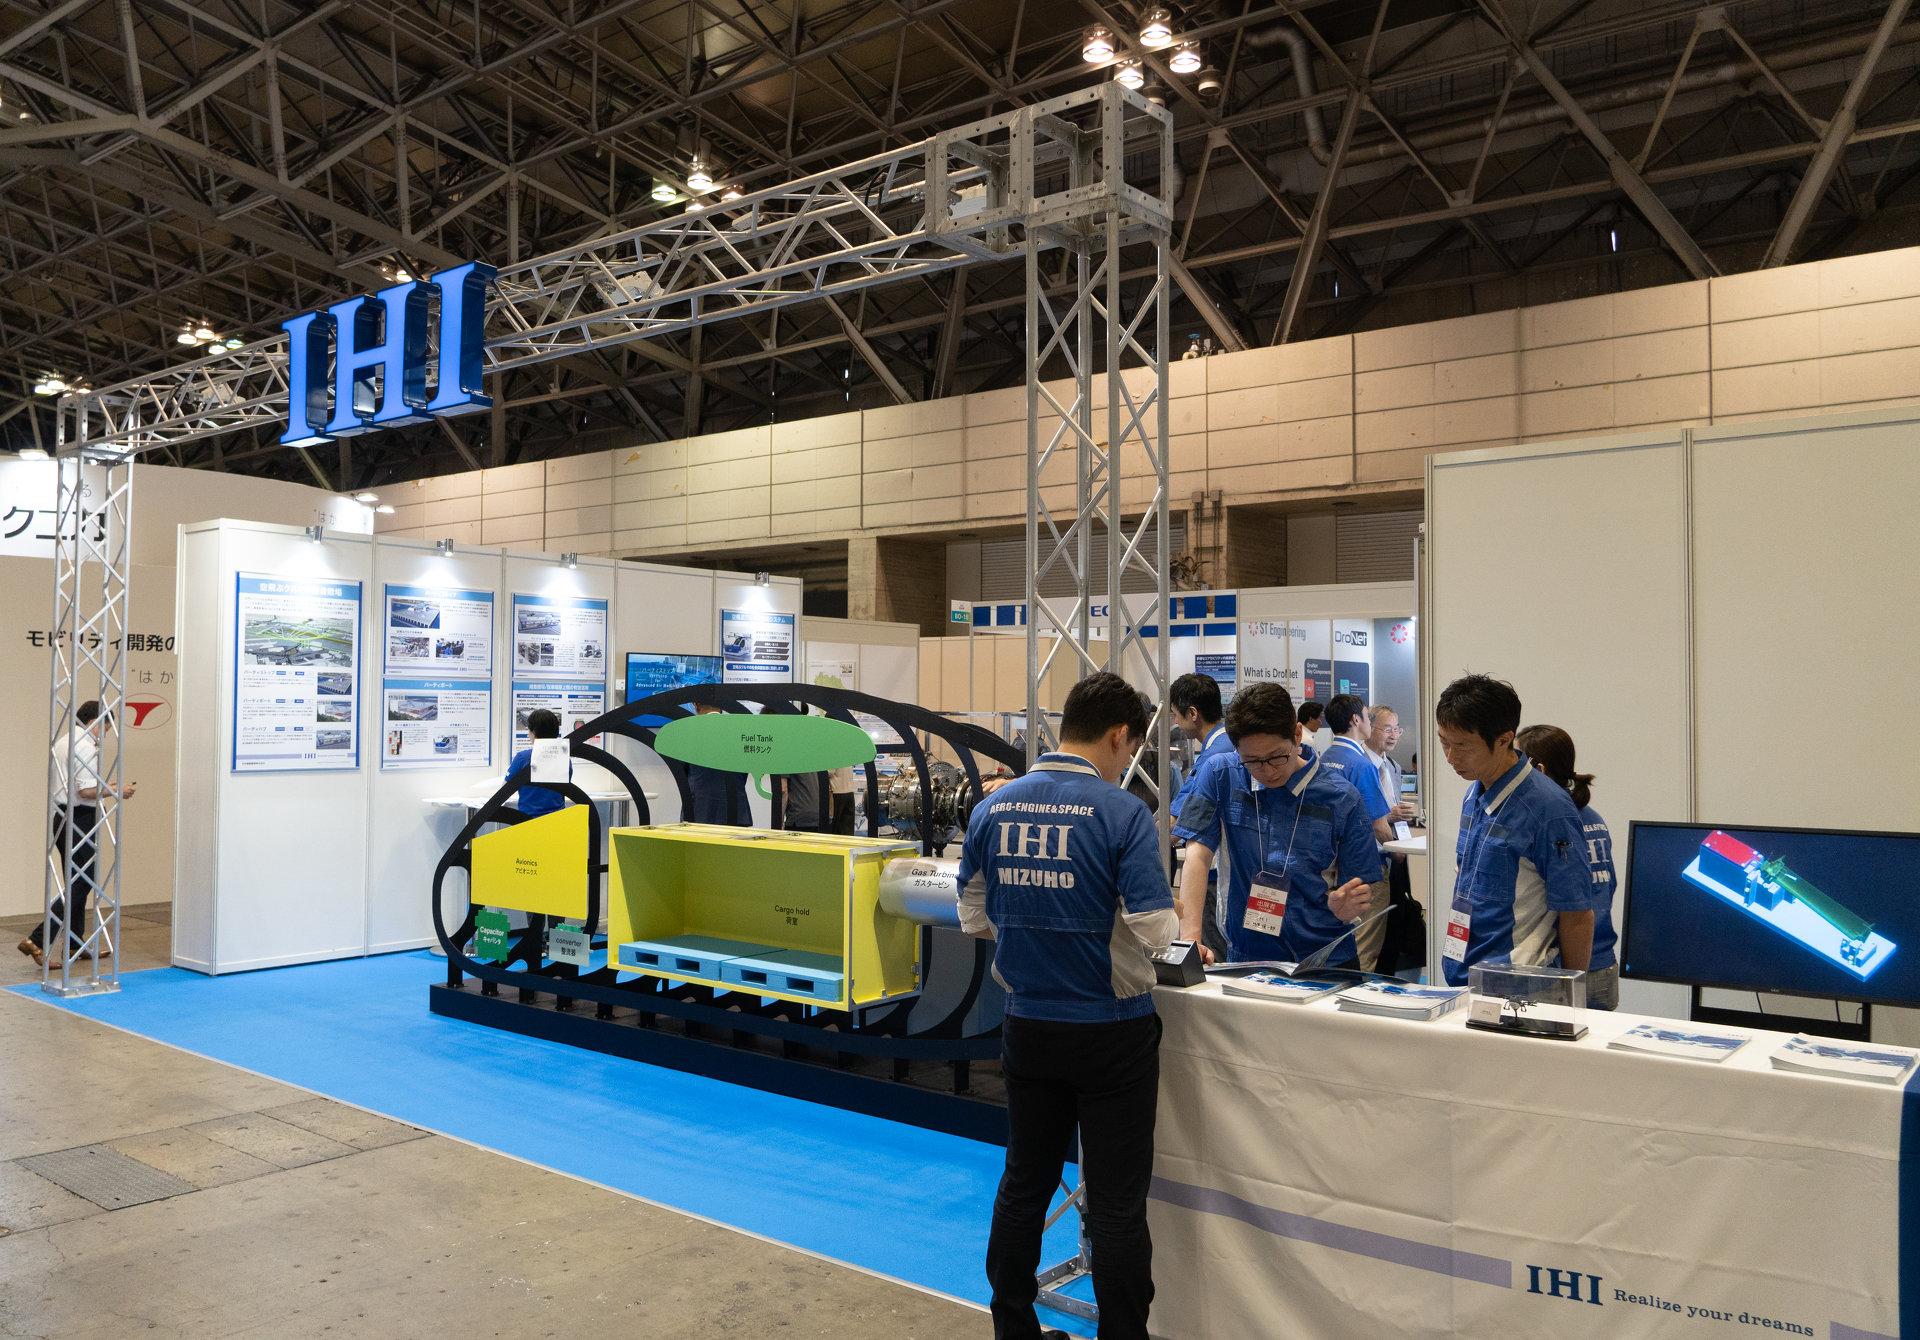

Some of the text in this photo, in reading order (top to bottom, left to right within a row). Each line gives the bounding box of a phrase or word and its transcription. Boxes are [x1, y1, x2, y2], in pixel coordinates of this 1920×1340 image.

[280, 260, 494, 447] IHI
[1260, 622, 1307, 640] ST Enginering
[1335, 631, 1367, 646] DroNet
[1244, 666, 1263, 678] What
[1265, 667, 1271, 678] is
[741, 734, 774, 742] Fuel Tank
[743, 745, 771, 754] 燃料タンク
[990, 802, 1094, 817] AERO-ENGINE&SPACE
[996, 822, 1074, 861] IHI
[515, 858, 538, 867] Avionics
[911, 868, 928, 877] Gas
[997, 867, 1075, 889] MIZUHO
[913, 879, 950, 889] ガスタービン
[774, 904, 810, 916] Cargo hold
[480, 926, 505, 938] Capacitor
[555, 937, 583, 947] converter
[1526, 1264, 1815, 1338] IHI Realize your dreams
